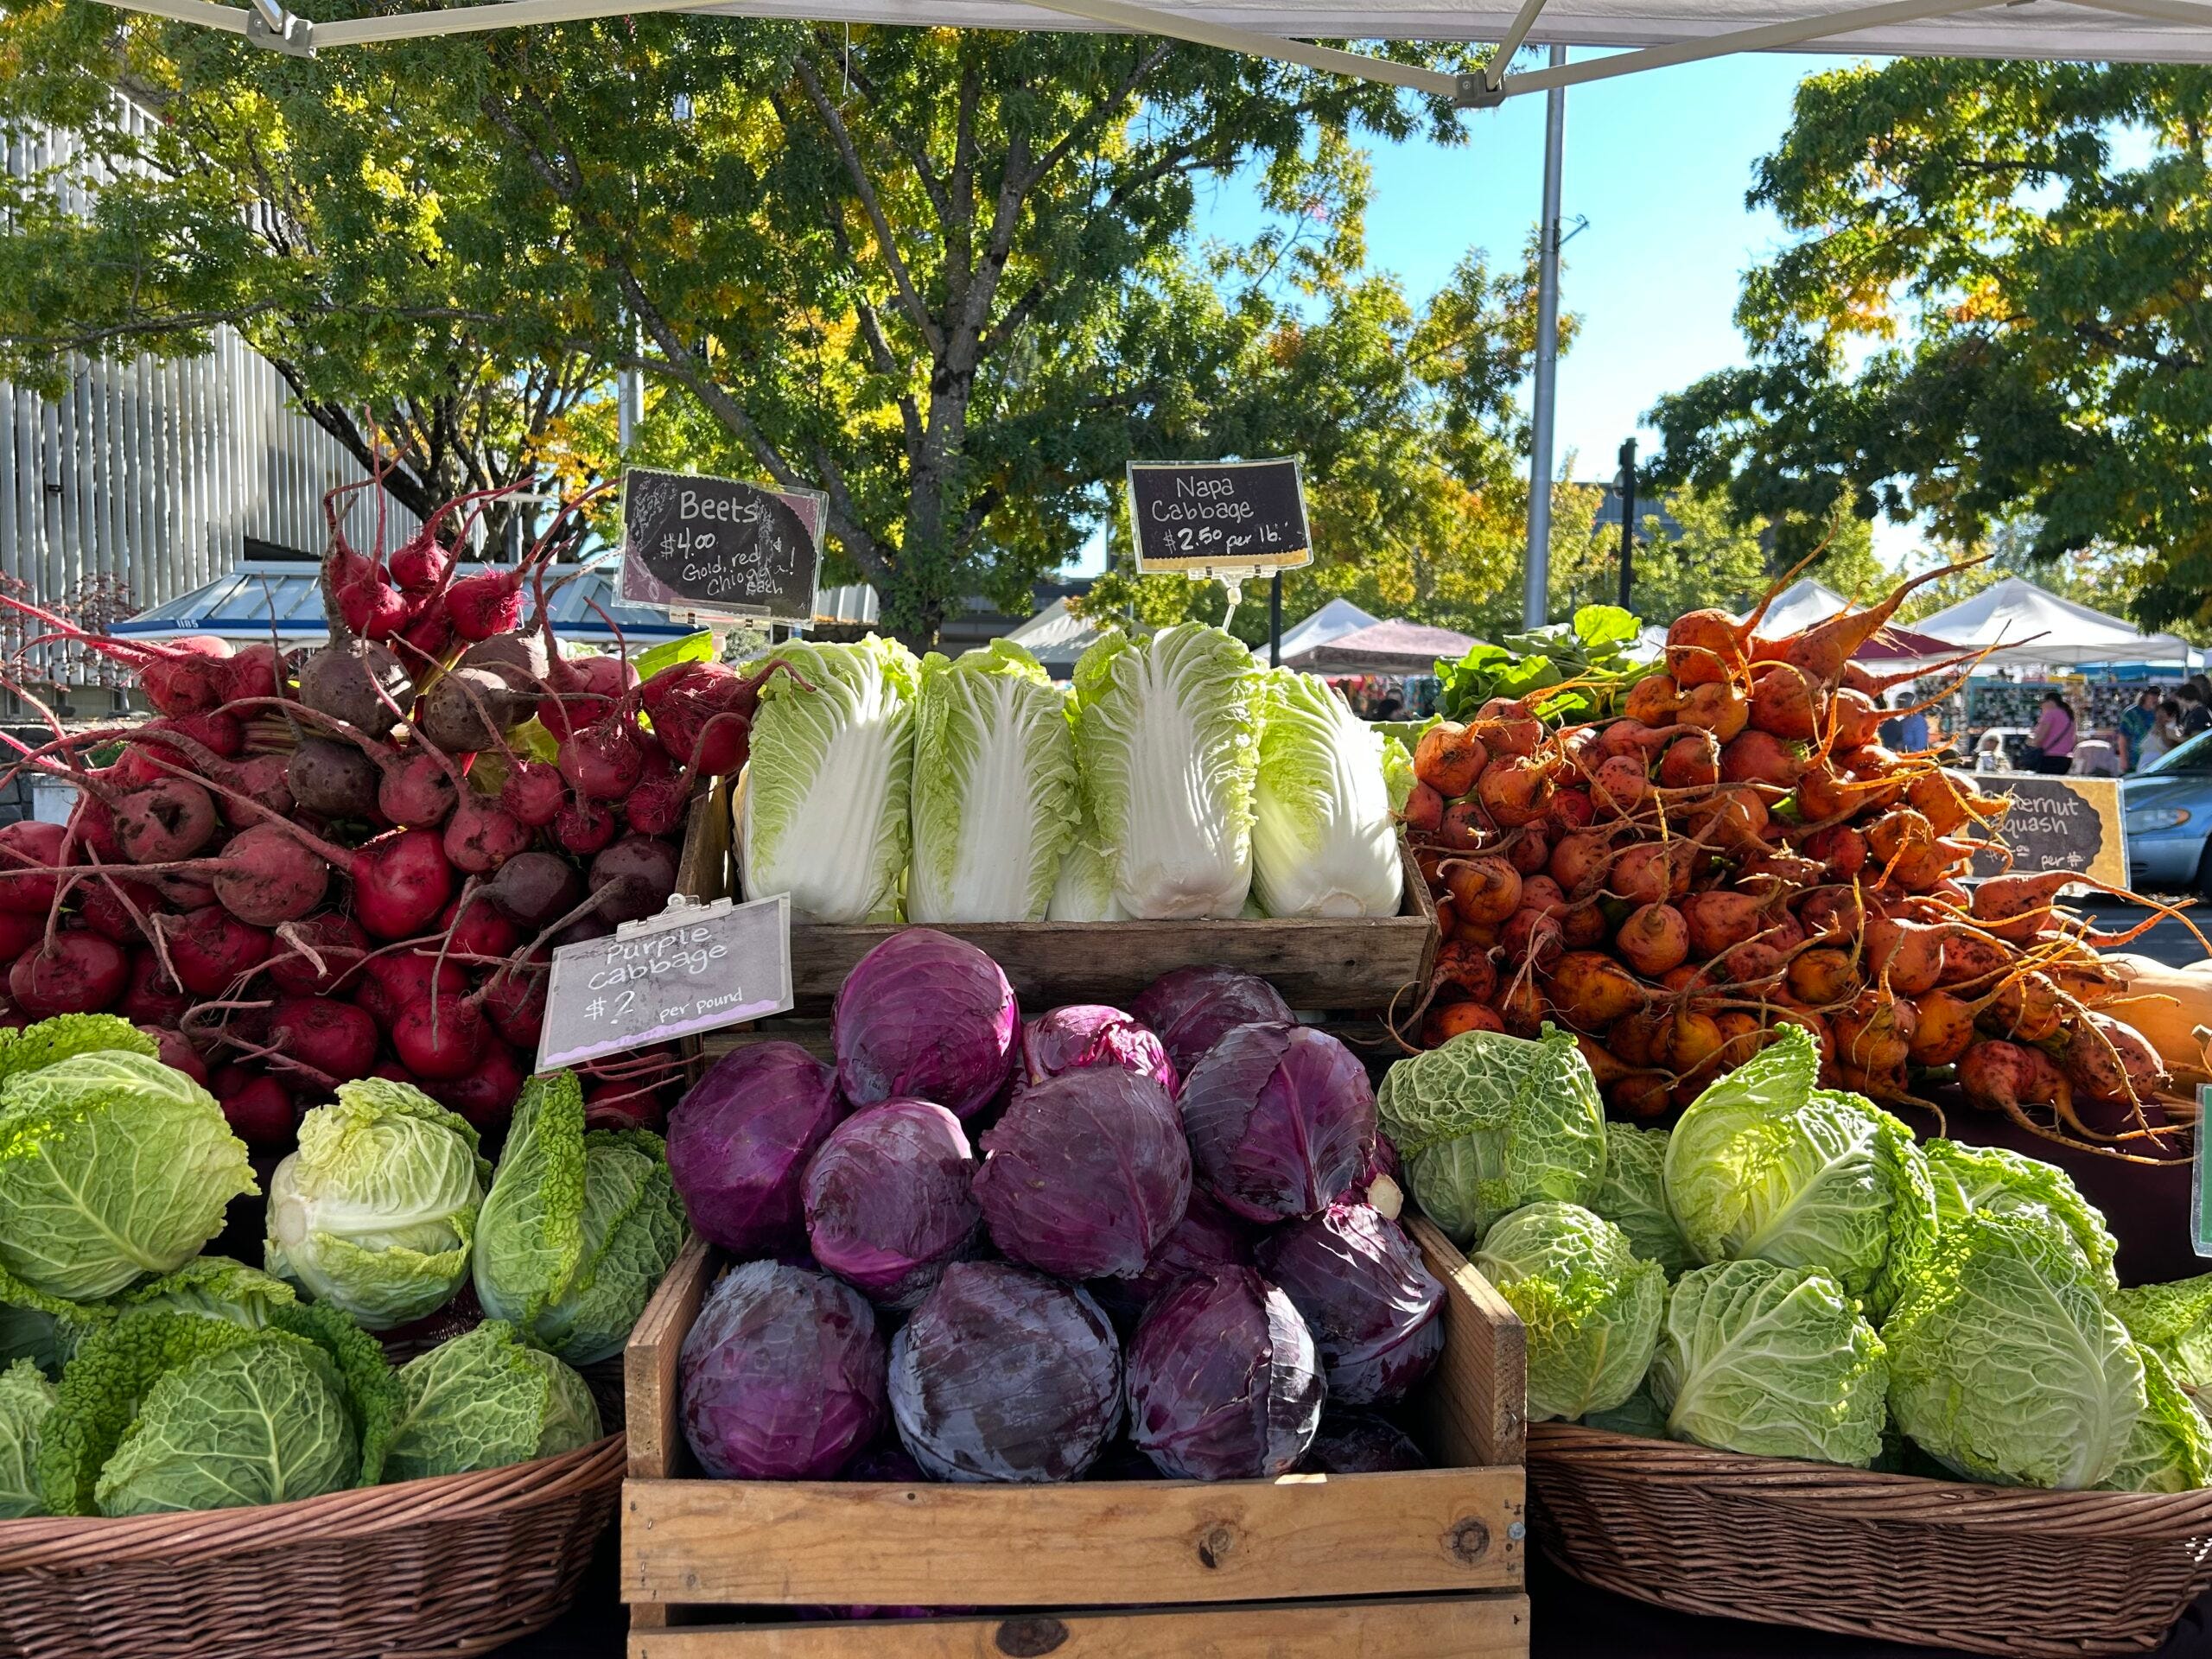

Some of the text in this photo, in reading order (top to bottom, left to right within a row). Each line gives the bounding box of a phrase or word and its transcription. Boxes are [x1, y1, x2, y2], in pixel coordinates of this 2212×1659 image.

[1176, 475, 1235, 499] Napa
[680, 490, 758, 524] Beets
[1152, 499, 1255, 524] Cabbage
[659, 527, 716, 560] $4.00
[1163, 526, 1223, 555] $2.50
[1225, 535, 1252, 555] per
[683, 555, 727, 582] Gold,
[733, 543, 760, 567] red
[746, 578, 783, 596] each
[2041, 854, 2066, 870] per
[659, 1002, 691, 1024] per
[696, 987, 743, 1015] pound
